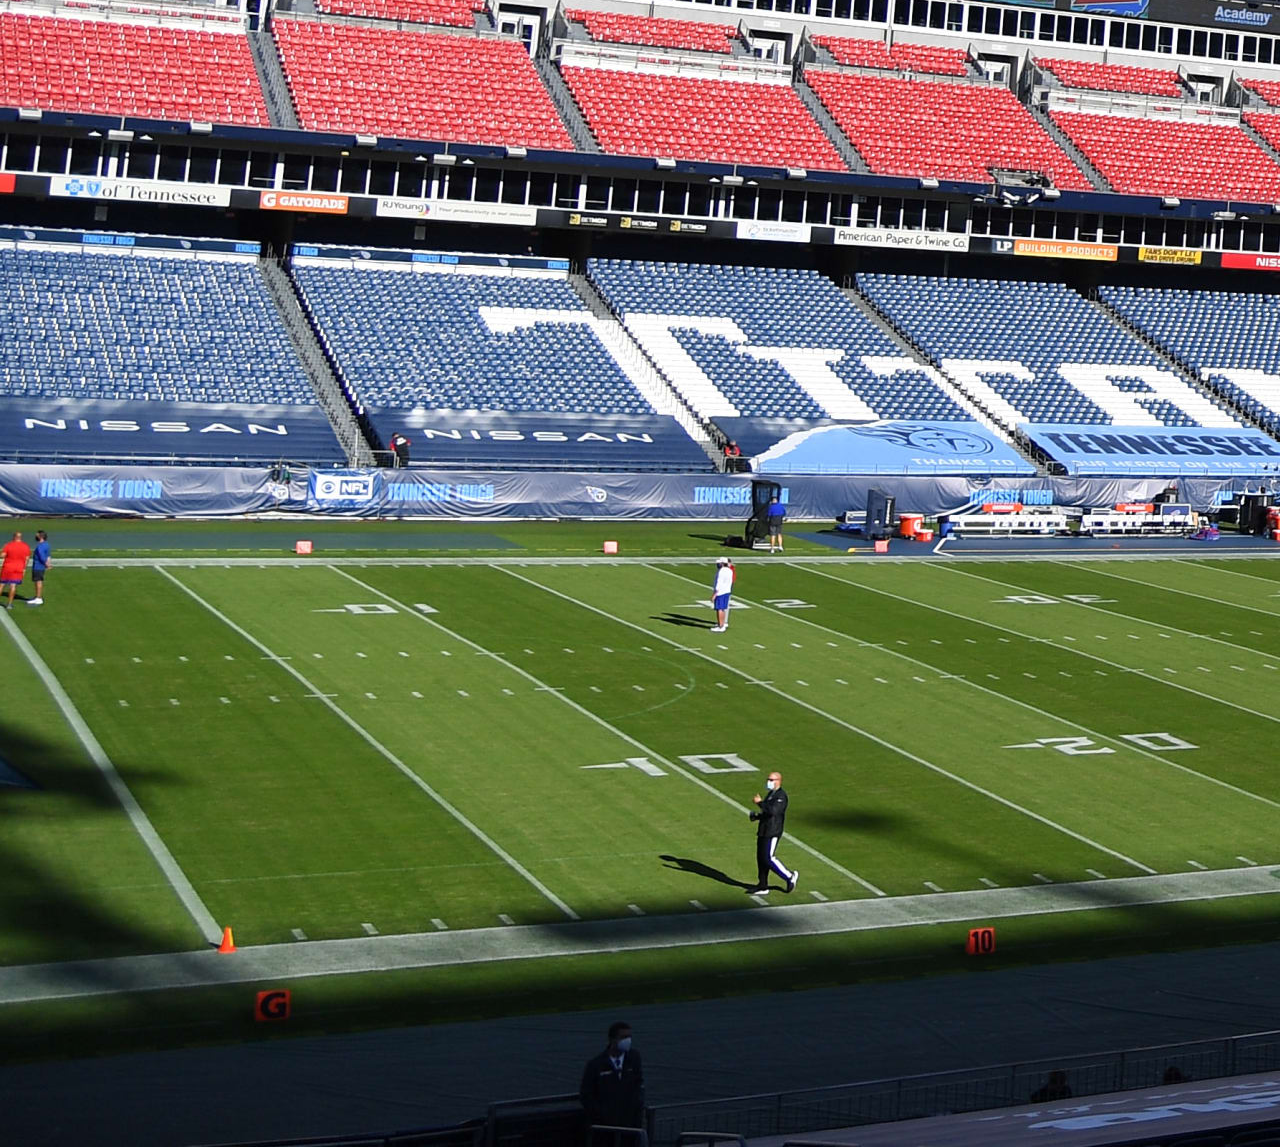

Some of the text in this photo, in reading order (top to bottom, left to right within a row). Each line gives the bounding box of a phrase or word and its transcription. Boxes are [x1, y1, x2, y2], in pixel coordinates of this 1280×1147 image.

[1214, 6, 1271, 26] Academy
[102, 184, 216, 204] of Tennessee
[280, 195, 346, 211] GATORADE
[382, 200, 426, 214] RJYoung
[838, 230, 968, 249] American Paper & Twine Co.
[995, 239, 1115, 258] LP BUILDING PRODUCTS
[24, 418, 288, 435] NISSAN
[423, 428, 655, 444] NISSAN
[911, 457, 1016, 467] THANKS TO
[1072, 459, 1107, 468] OUR
[1112, 459, 1180, 469] HEROES
[1184, 460, 1209, 469] ON
[1213, 461, 1245, 469] THE
[41, 478, 162, 500] TENNESSEE TOUGH
[339, 480, 371, 496] NFL
[388, 482, 494, 503] TENNESSEE TOUGH
[1023, 490, 1054, 505] TOUGH
[1040, 733, 1199, 756] 20
[626, 753, 760, 777] 10
[970, 928, 994, 952] 10
[259, 992, 289, 1019] G
